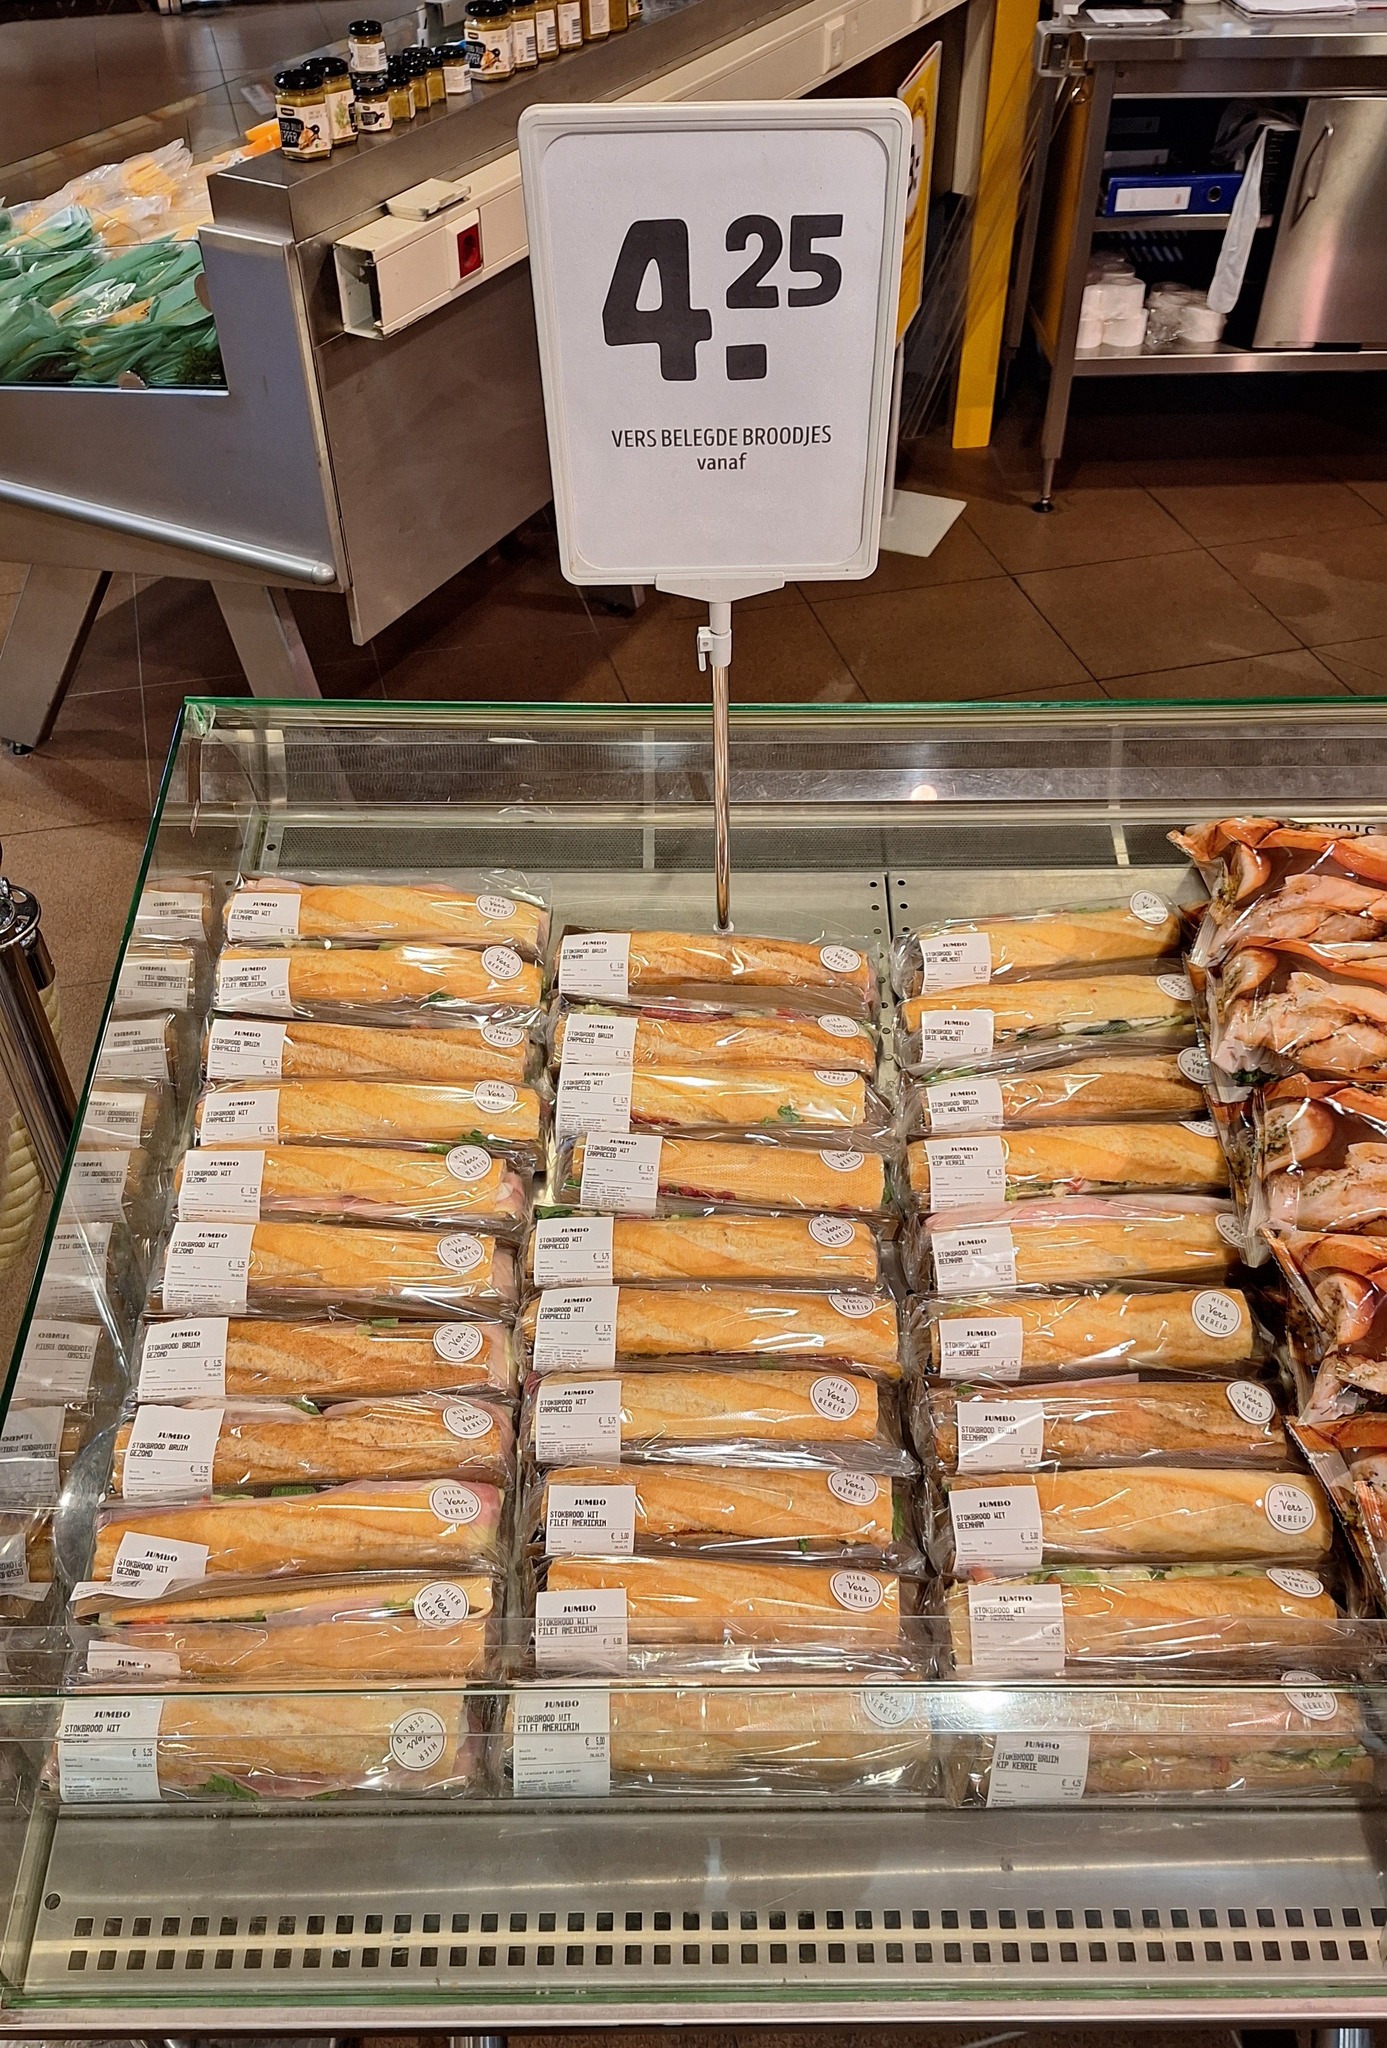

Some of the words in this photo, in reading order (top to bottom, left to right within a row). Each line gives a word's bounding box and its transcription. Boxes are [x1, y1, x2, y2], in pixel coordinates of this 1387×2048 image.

[611, 430, 657, 447] VERS
[661, 428, 738, 446] BELEGDE
[742, 425, 832, 446] BROODJES
[697, 452, 748, 470] vanaf
[500, 950, 515, 960] HIER
[496, 955, 510, 968] Vers
[826, 956, 847, 968] BEREID
[488, 961, 510, 975] BEREID
[454, 1150, 468, 1159] HIER
[460, 1156, 478, 1166] Vers
[465, 1160, 487, 1176] BEREID
[822, 1225, 841, 1234] Vers
[828, 1230, 849, 1242] BEREID
[451, 1245, 471, 1254] Vers
[455, 1250, 480, 1265] BEREID
[1211, 1297, 1229, 1308] HIER
[1208, 1304, 1227, 1320] Vers
[1200, 1314, 1227, 1330] BEREID
[440, 1329, 453, 1340] HIER
[448, 1331, 466, 1346] Vers
[148, 1342, 179, 1351] STOKBROOD
[458, 1334, 477, 1355] BEREID
[830, 1382, 848, 1392] HIER
[1244, 1386, 1263, 1396] HIER
[826, 1389, 845, 1403] Vers
[1243, 1392, 1263, 1408] Vers
[819, 1398, 845, 1414] BEREID
[1237, 1399, 1263, 1417] BEREID
[463, 1419, 488, 1432] BEREID
[845, 1480, 865, 1490] Vers
[837, 1487, 866, 1500] BEREID
[1280, 1500, 1303, 1512] Vers
[956, 1513, 990, 1521] STOKBROOD
[1277, 1514, 1306, 1523] BEREID
[145, 1551, 178, 1562] JUMBO
[118, 1558, 153, 1570] STOKBROOD
[117, 1566, 140, 1577] GEZOND
[846, 1581, 869, 1592] Vers
[1283, 1581, 1314, 1590] BEREID
[444, 1588, 461, 1605] HIER
[843, 1592, 873, 1603] BEREID
[434, 1594, 450, 1616] Vers
[518, 1715, 556, 1723] STOKBROOD
[558, 1714, 571, 1722] WIT
[65, 1724, 103, 1733] STOKBROOD
[106, 1724, 120, 1732] WIT
[518, 1724, 538, 1732] FILET
[542, 1722, 580, 1731] AMERICAIN
[1025, 1741, 1060, 1749] JUMBO
[420, 1743, 438, 1761] HIER
